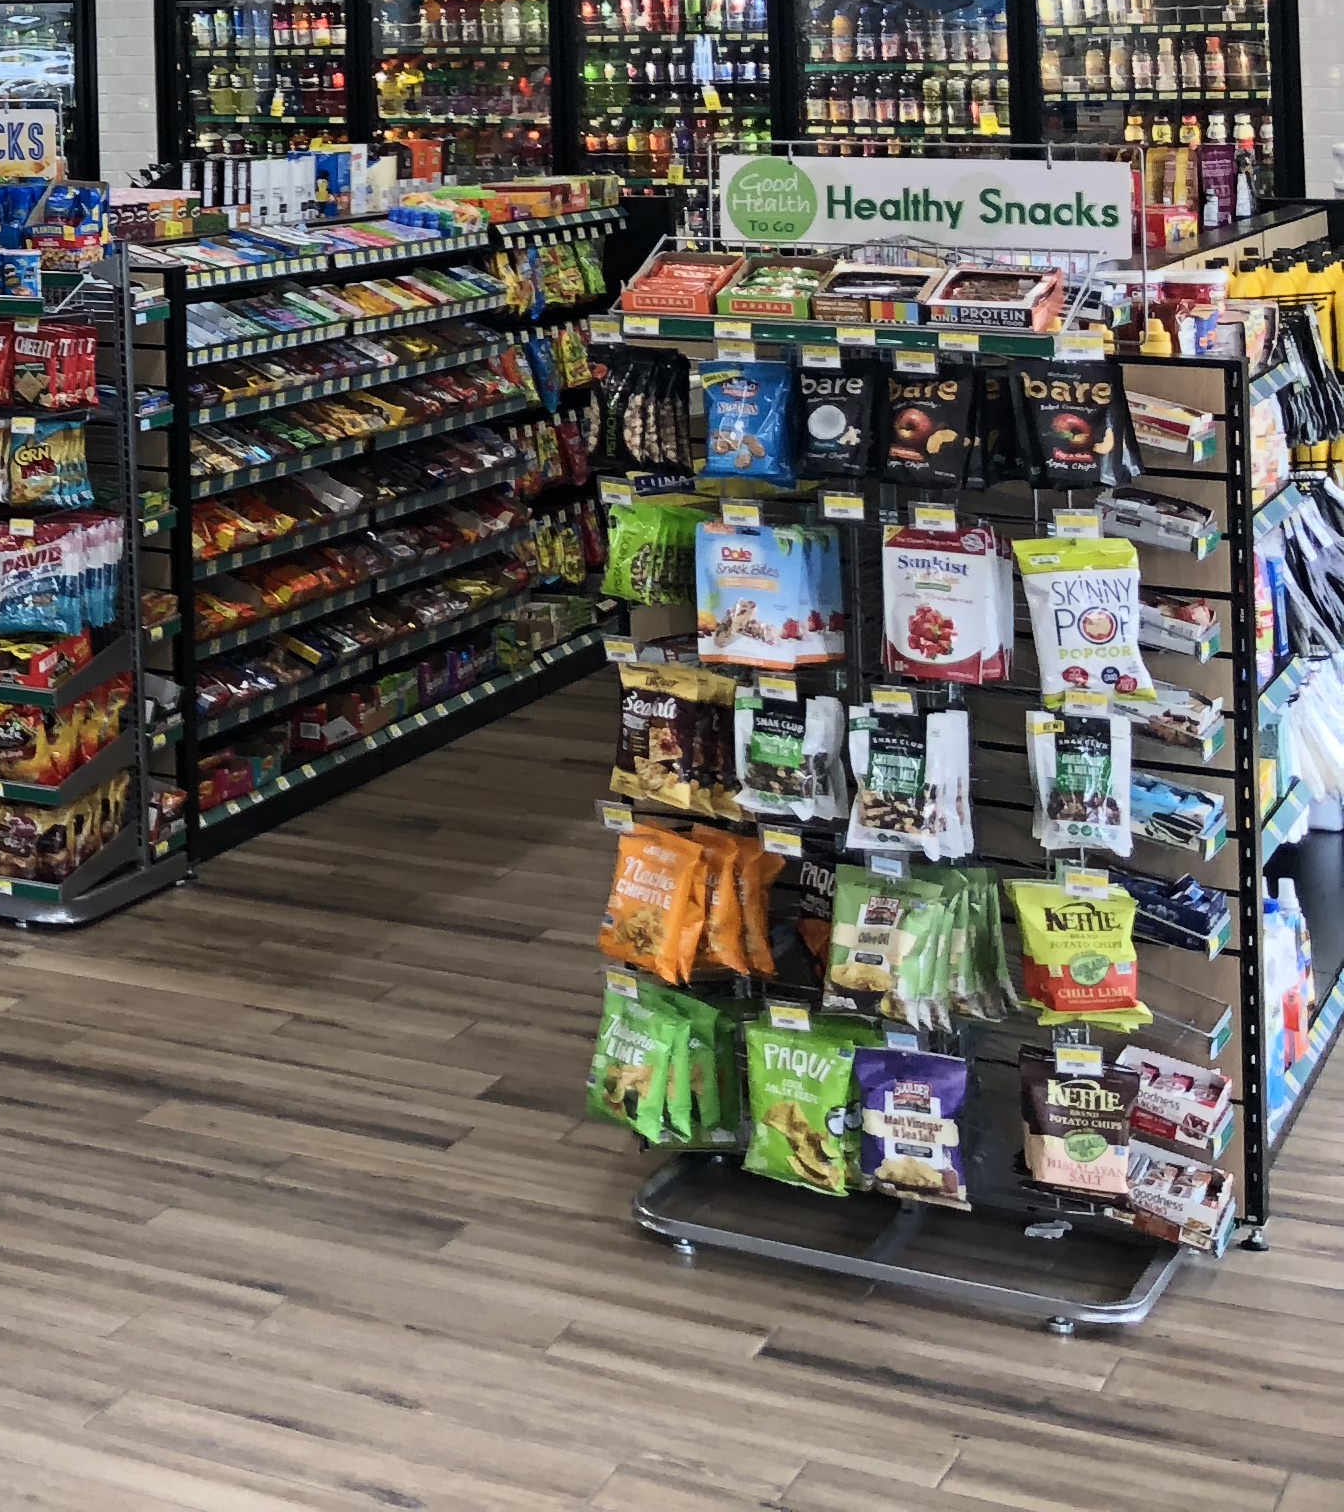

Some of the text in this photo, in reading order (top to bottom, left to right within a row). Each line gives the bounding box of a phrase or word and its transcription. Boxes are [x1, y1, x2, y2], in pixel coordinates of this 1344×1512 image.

[739, 173, 799, 194] Good
[732, 192, 811, 214] Health
[826, 184, 1119, 229] Healthy Snacks
[637, 296, 691, 307] LARABAR
[734, 301, 787, 312] LARABAR
[961, 308, 1025, 321] PROTEIN
[801, 374, 864, 395] bare
[1021, 372, 1111, 404] bare
[15, 445, 52, 466] CORN
[722, 546, 752, 562] Dole
[716, 563, 748, 575] Snack
[898, 554, 969, 577] Sunkist
[1052, 575, 1132, 606] SKINNY
[1055, 606, 1130, 646] POP
[1058, 646, 1133, 660] POPCOR
[624, 856, 676, 889] Nacho
[616, 880, 671, 911] CHIPOTLE
[1044, 902, 1123, 932] KETTLE
[1050, 941, 1122, 949] POTATO CHIPS
[1057, 986, 1132, 998] CHILI LIME
[606, 1040, 645, 1066] LIME
[1045, 1078, 1124, 1112] KETTLE
[1138, 1090, 1180, 1110] oodness
[884, 1114, 943, 1133] Malt Vinegar
[1048, 1113, 1123, 1131] POTATO CHIPS
[917, 1131, 935, 1143] Salt
[1046, 1158, 1124, 1179] HIMALAYAN
[1069, 1171, 1105, 1186] SALT
[1133, 1188, 1184, 1212] goodness
